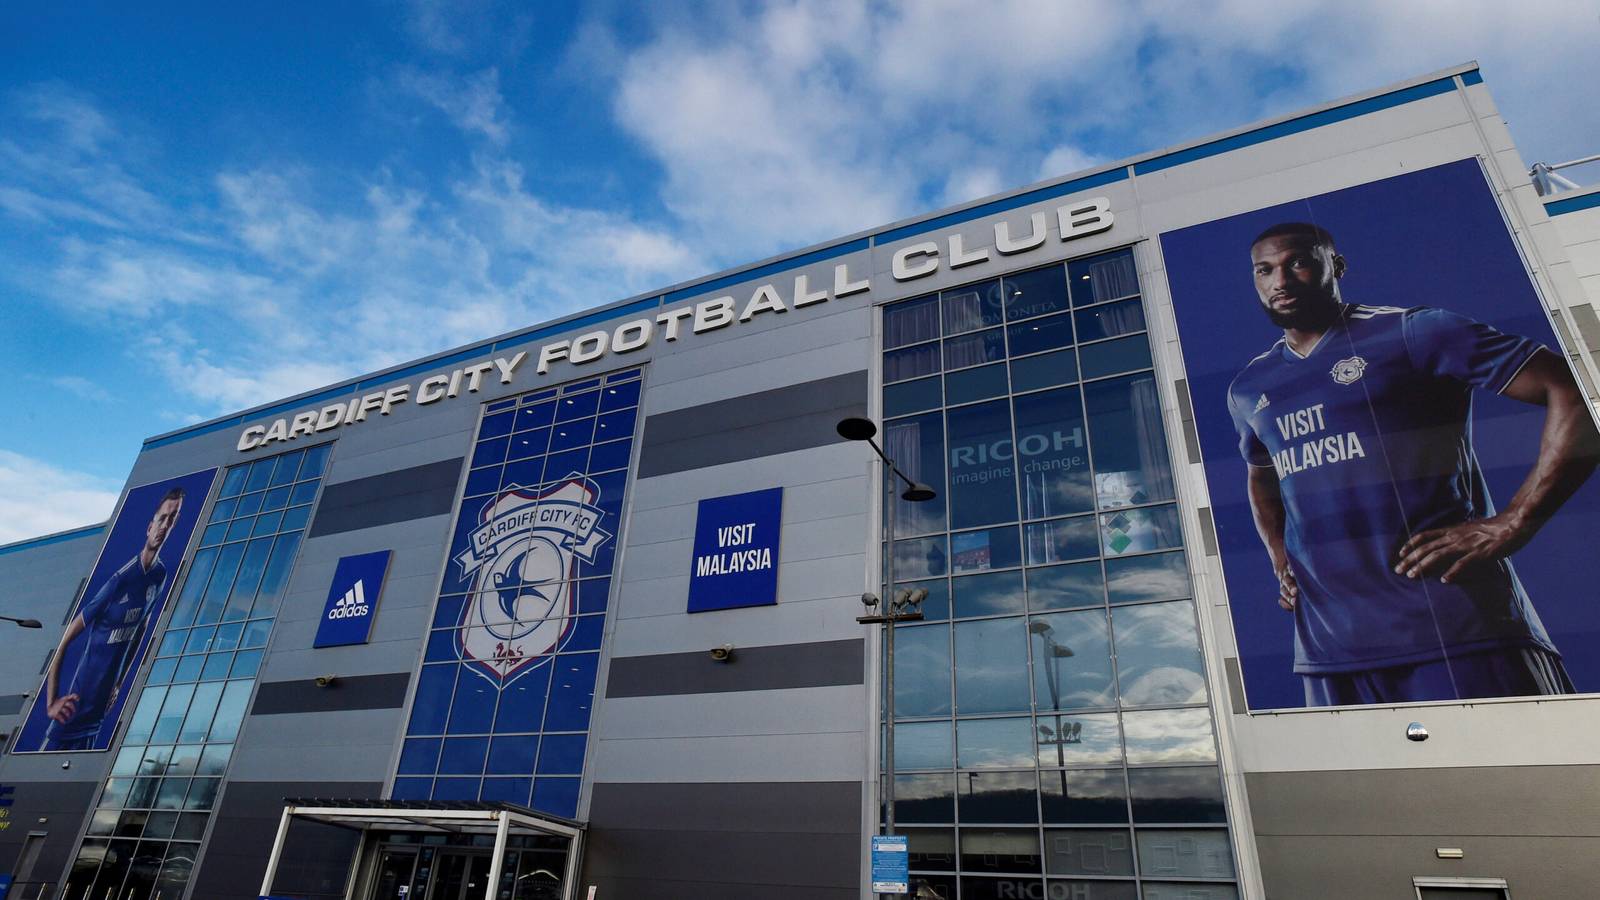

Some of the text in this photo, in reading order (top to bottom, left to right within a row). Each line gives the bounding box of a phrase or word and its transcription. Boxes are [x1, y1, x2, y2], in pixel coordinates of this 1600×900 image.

[236, 196, 1114, 452] CARDIFF CITY FOOTBALL CLUB
[1276, 403, 1326, 441] VISIT
[951, 427, 1084, 468] RICOH
[1024, 455, 1086, 474] change.
[478, 509, 591, 546] CARDIFF CITY FC
[718, 523, 756, 548] VISIT
[696, 547, 772, 577] MALAYSIA
[328, 603, 369, 620] adidas
[996, 880, 1091, 900] RICOH
